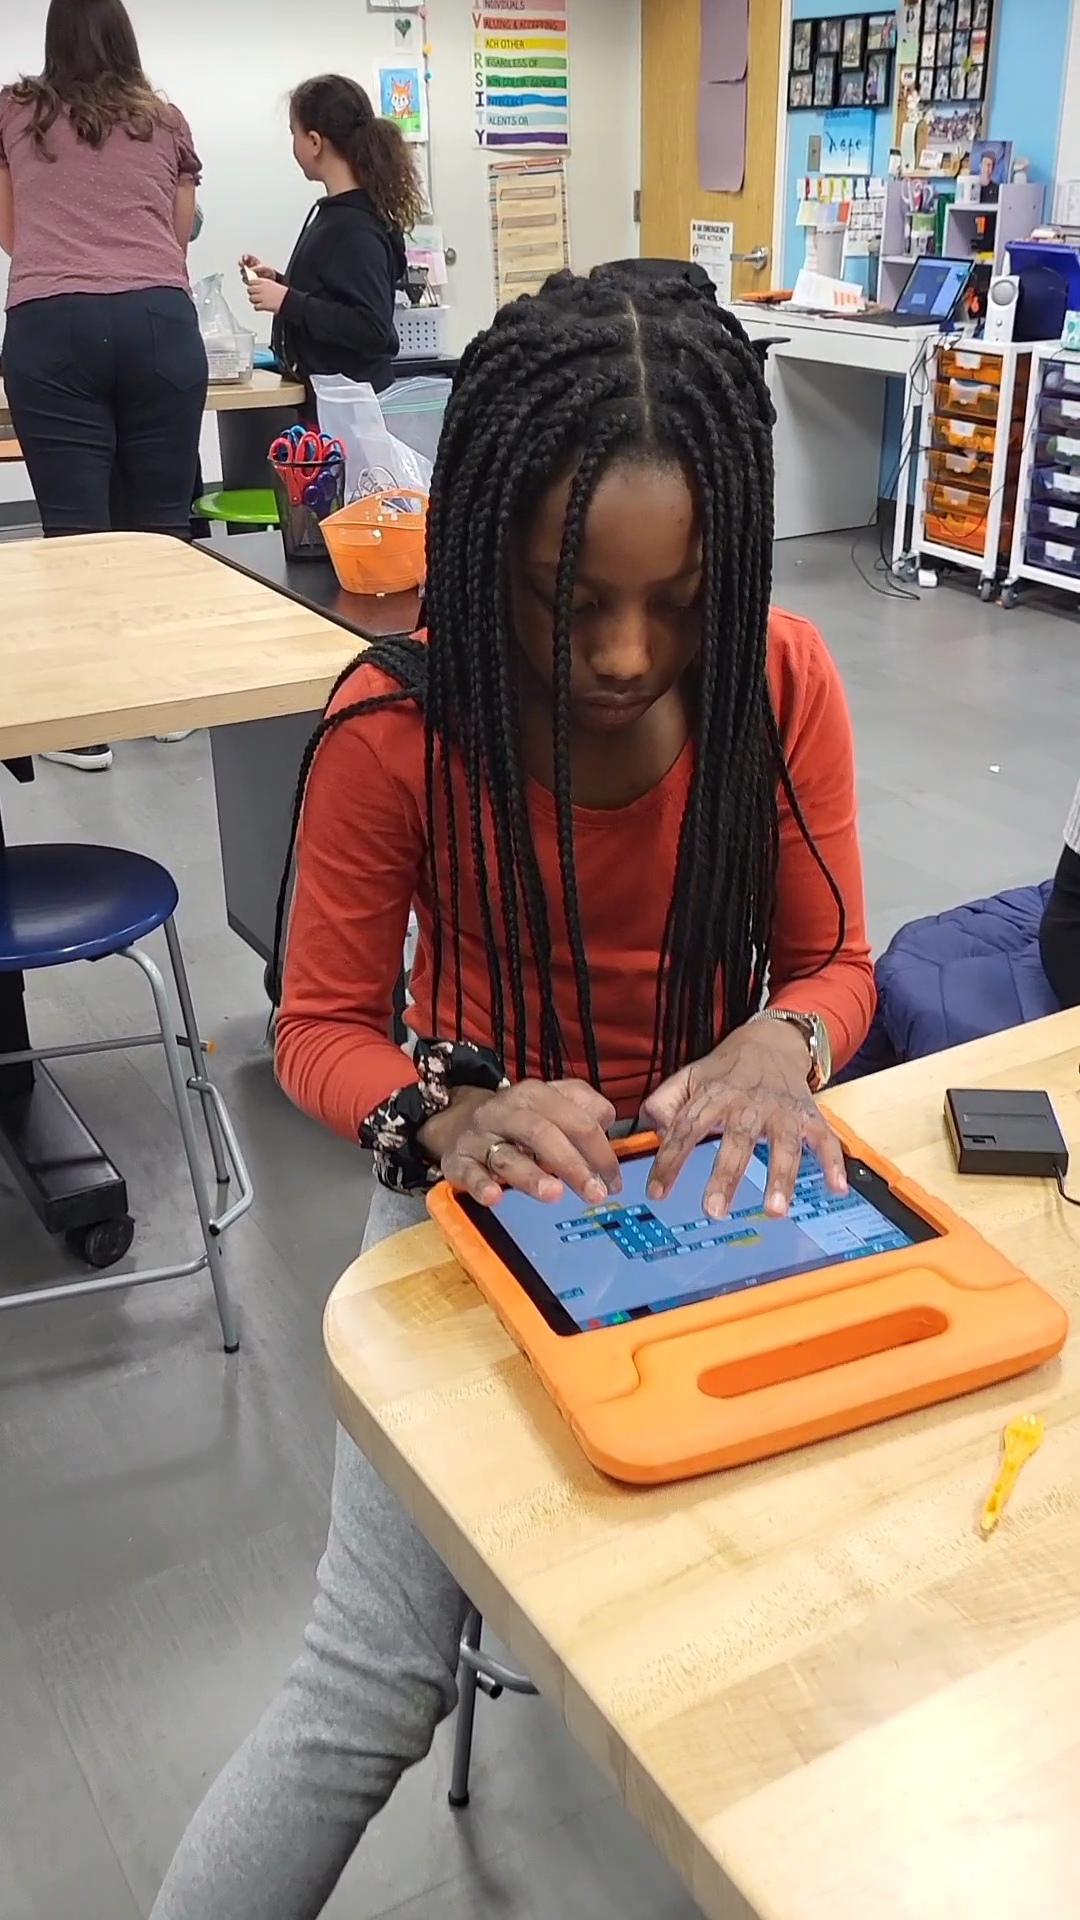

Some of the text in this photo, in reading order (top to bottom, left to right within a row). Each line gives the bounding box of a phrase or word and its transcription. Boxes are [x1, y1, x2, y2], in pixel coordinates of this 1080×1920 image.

[472, 13, 481, 29] V
[501, 39, 525, 49] OTHER
[474, 53, 482, 68] R
[529, 58, 538, 68] OF
[475, 72, 483, 87] S
[475, 92, 484, 107] I
[488, 116, 516, 125] ALENTS
[475, 129, 485, 145] Y
[703, 225, 730, 234] EMERGENCY
